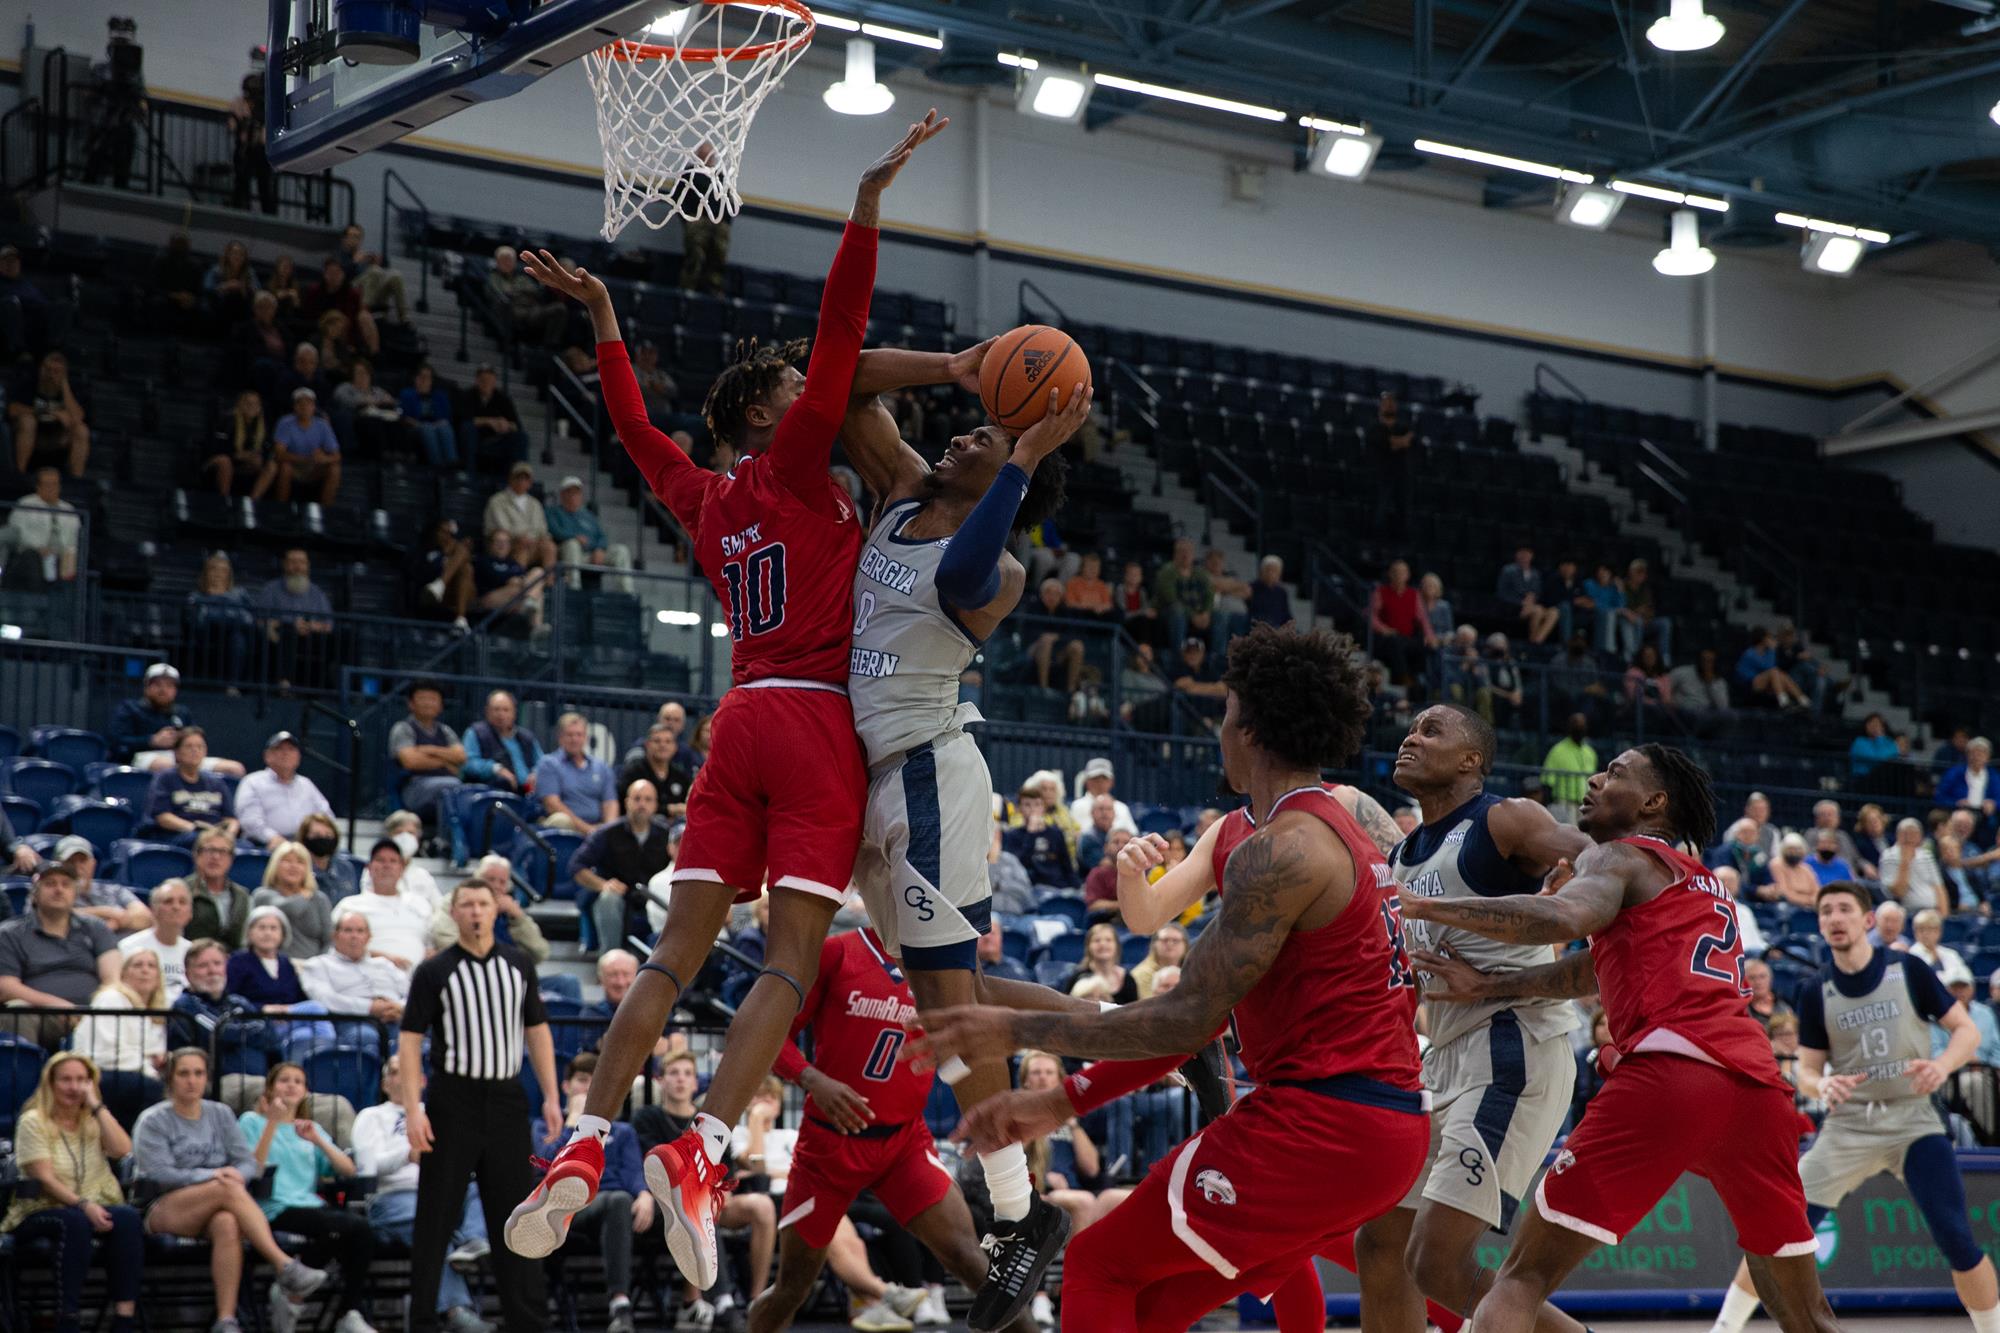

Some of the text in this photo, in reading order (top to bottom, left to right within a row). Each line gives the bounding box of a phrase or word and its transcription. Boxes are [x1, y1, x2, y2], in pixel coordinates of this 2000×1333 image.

[721, 542, 787, 641] 10
[853, 589, 876, 636] 0
[850, 647, 900, 678] HERN
[1837, 1001, 1901, 1030] GEORGIA
[861, 1027, 906, 1083] 0
[1861, 1028, 1889, 1060] 13
